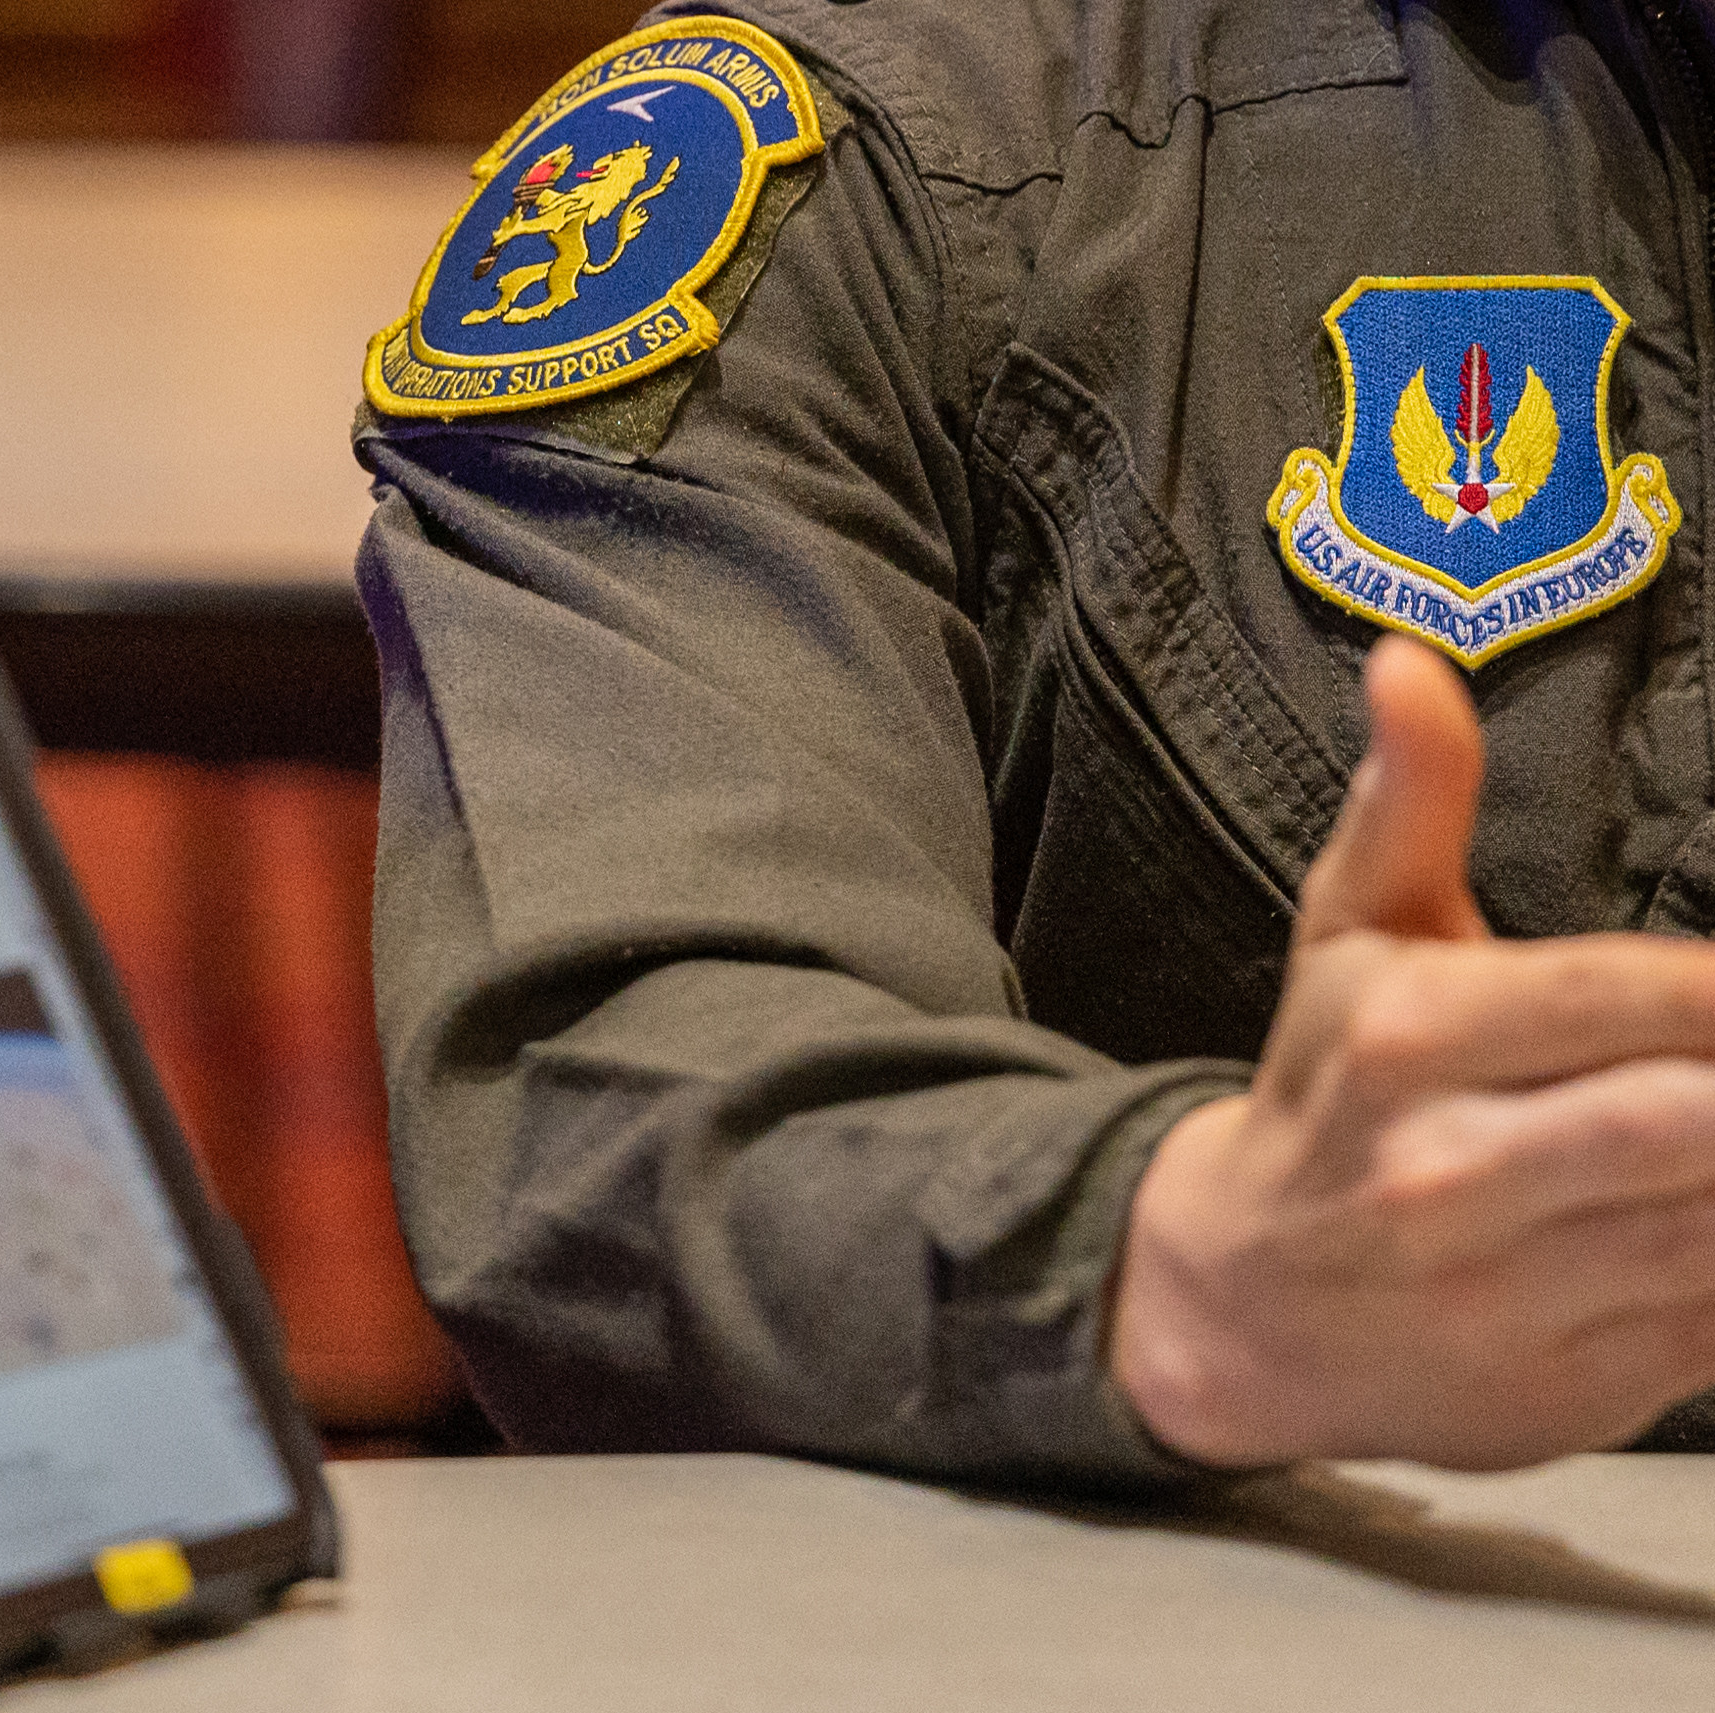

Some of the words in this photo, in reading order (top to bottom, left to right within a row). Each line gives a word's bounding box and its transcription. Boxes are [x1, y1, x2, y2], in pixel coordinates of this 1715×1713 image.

[607, 42, 713, 80] SOLUM
[704, 48, 780, 108] ARMIS
[506, 336, 632, 394] SUPPORT
[638, 314, 683, 351] SQ
[1333, 560, 1393, 608] AIR
[1393, 581, 1504, 647] FORCES
[1505, 584, 1542, 625] IN
[1539, 526, 1648, 610] EUROPE
